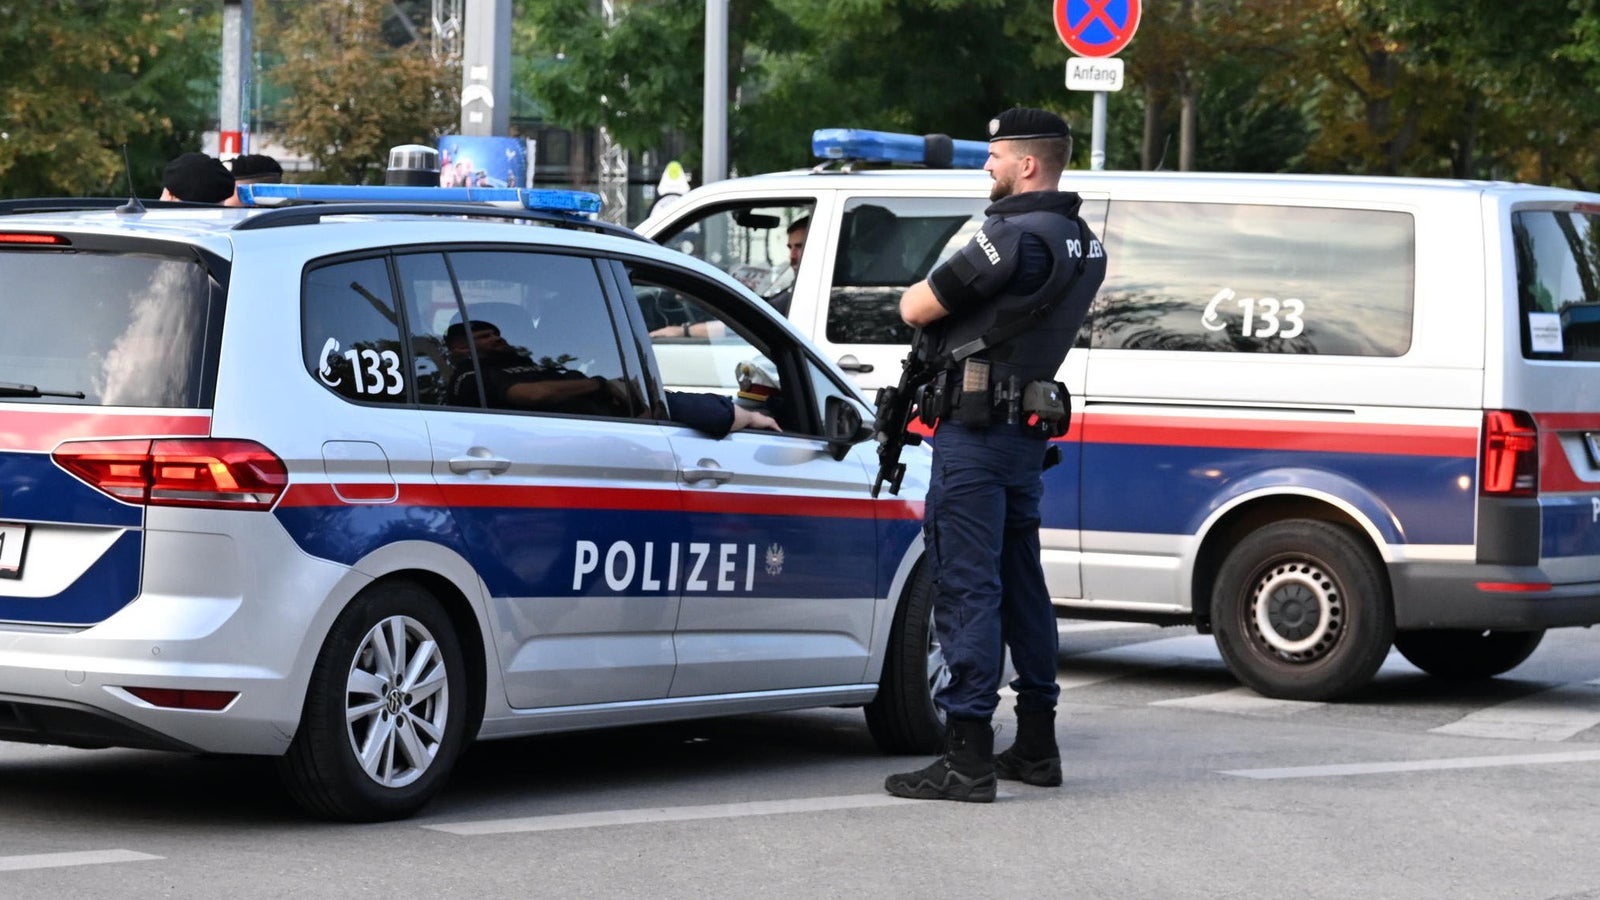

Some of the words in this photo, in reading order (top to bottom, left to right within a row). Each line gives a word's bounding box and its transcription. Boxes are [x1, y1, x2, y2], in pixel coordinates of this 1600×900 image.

[1073, 65, 1117, 85] Anfang
[975, 230, 1001, 265] POLIZEI
[1065, 238, 1103, 258] POZEI
[1238, 298, 1305, 338] 133
[344, 349, 404, 395] 133
[572, 540, 756, 592] POLIZEI
